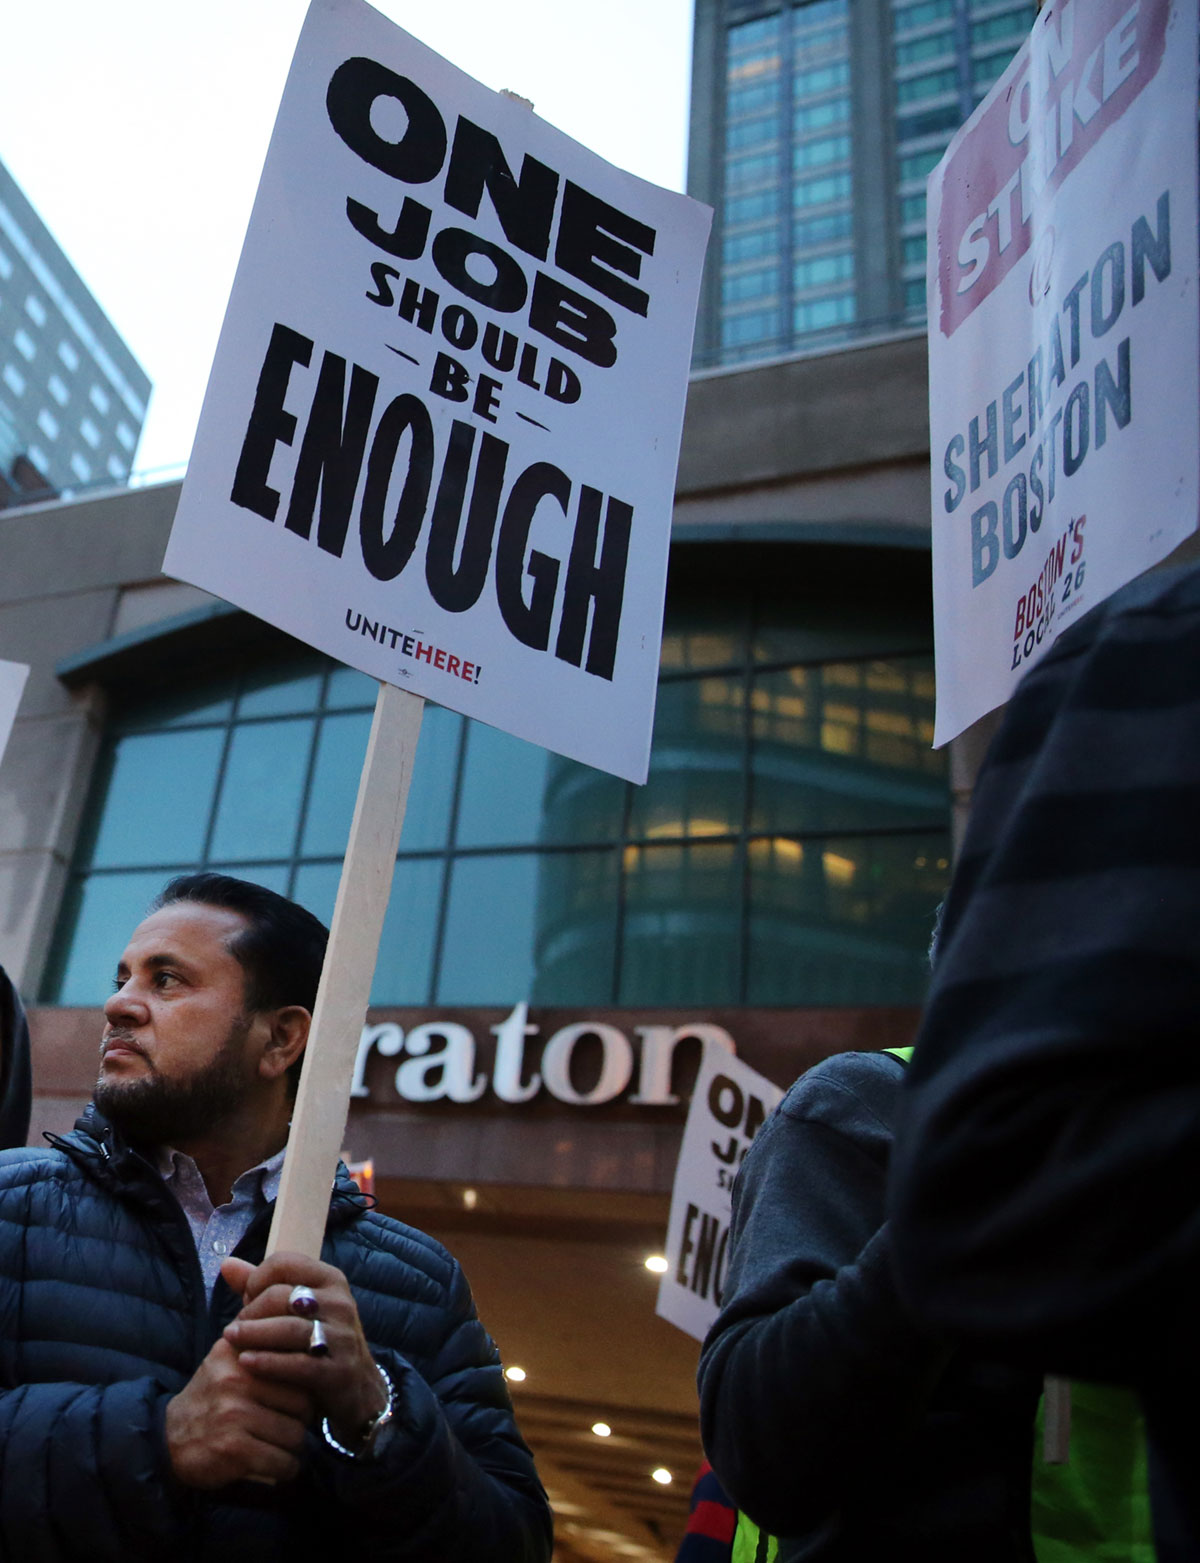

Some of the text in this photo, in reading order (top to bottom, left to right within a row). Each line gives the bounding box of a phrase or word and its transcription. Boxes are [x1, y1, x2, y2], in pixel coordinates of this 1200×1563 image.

[326, 57, 656, 318] ONE
[346, 196, 618, 368] JOB
[365, 262, 581, 404] SHOULD
[944, 189, 1171, 513] SHERATON
[429, 350, 502, 424] BE
[971, 337, 1132, 589] BOSTON
[230, 322, 634, 681] ENOUGH
[345, 608, 482, 685] UNITEHERE!
[1011, 592, 1055, 671] LOCAL
[1062, 561, 1086, 602] 26
